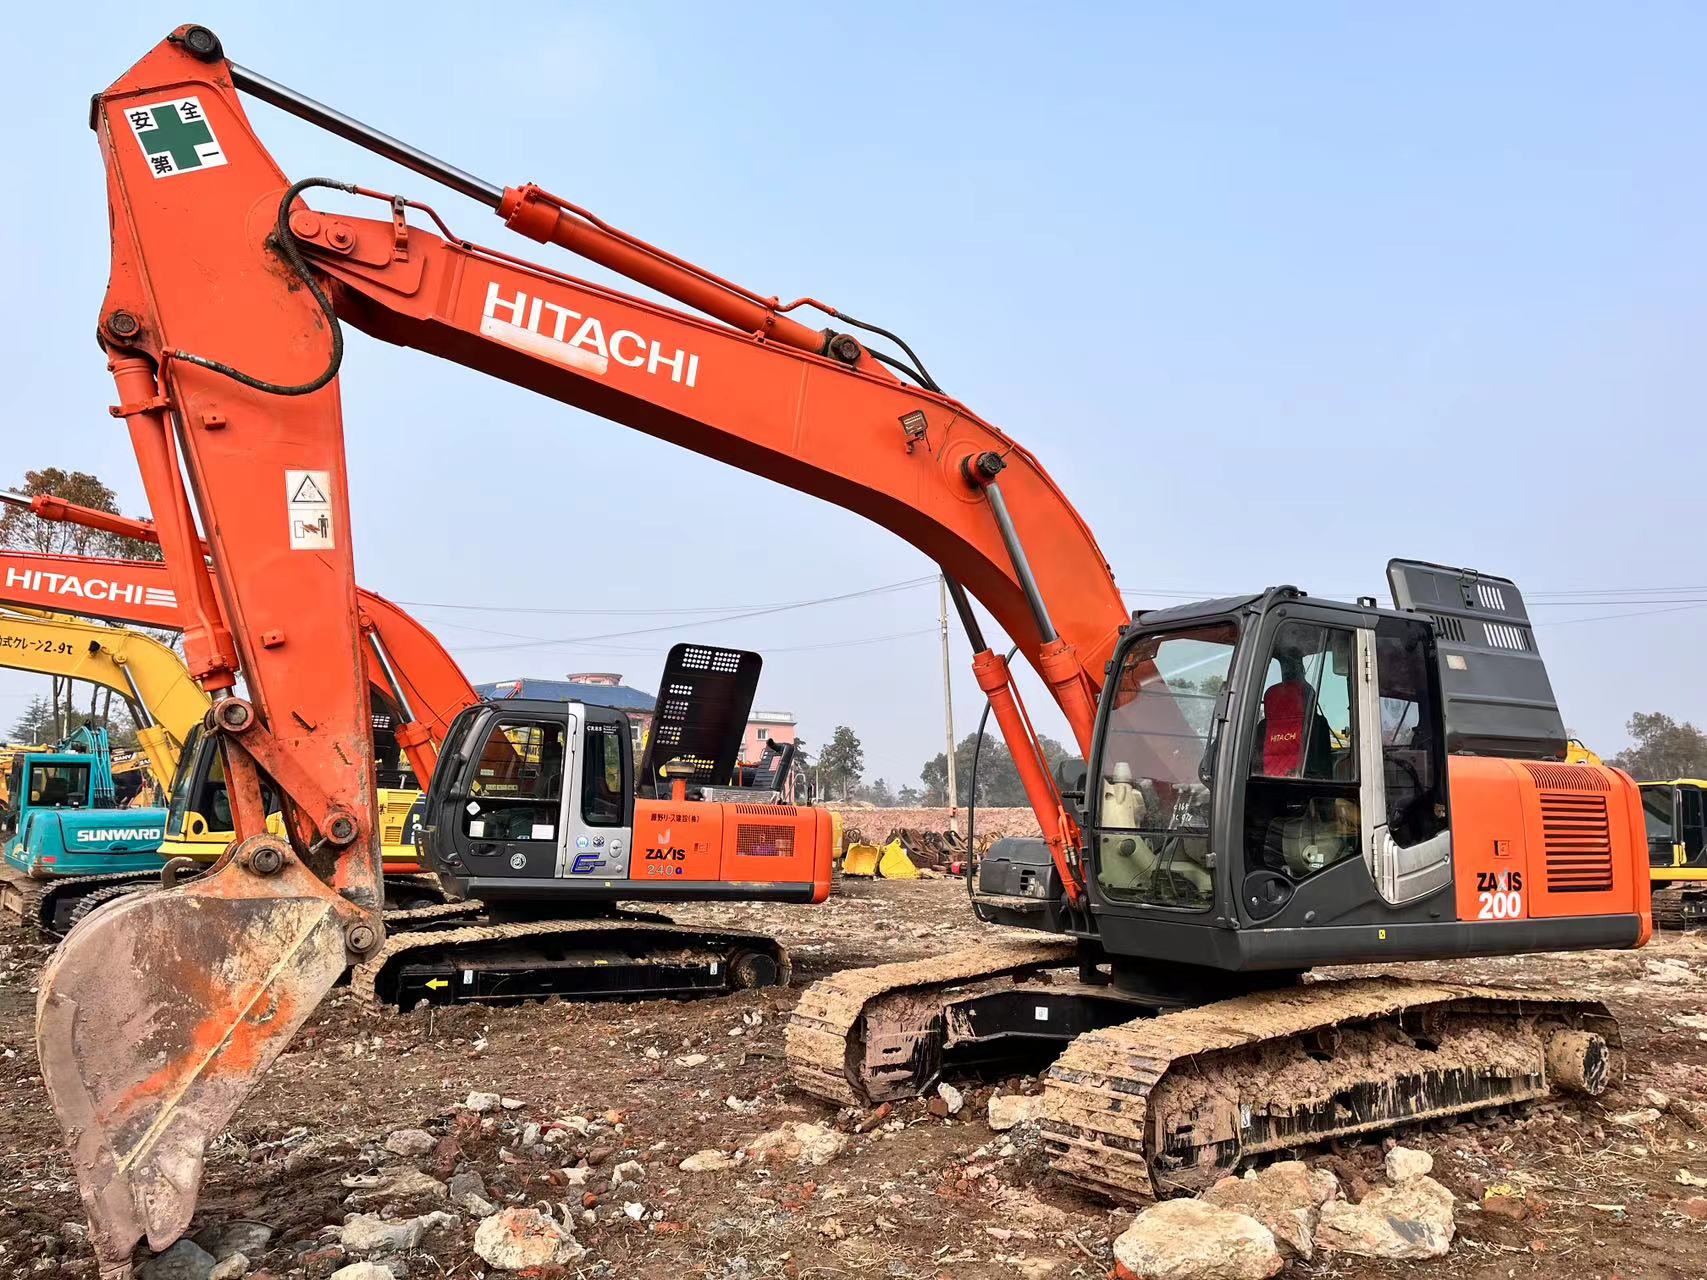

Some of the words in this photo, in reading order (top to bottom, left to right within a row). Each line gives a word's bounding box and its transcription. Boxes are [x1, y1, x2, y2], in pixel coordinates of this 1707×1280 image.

[483, 281, 699, 387] HITACHI
[5, 567, 143, 605] HITACHI
[1270, 732, 1297, 742] HITACHI
[77, 829, 161, 842] SUNWARD
[645, 847, 686, 860] ZAXIS
[1477, 869, 1523, 892] ZAXIS
[1478, 891, 1522, 920] 200
